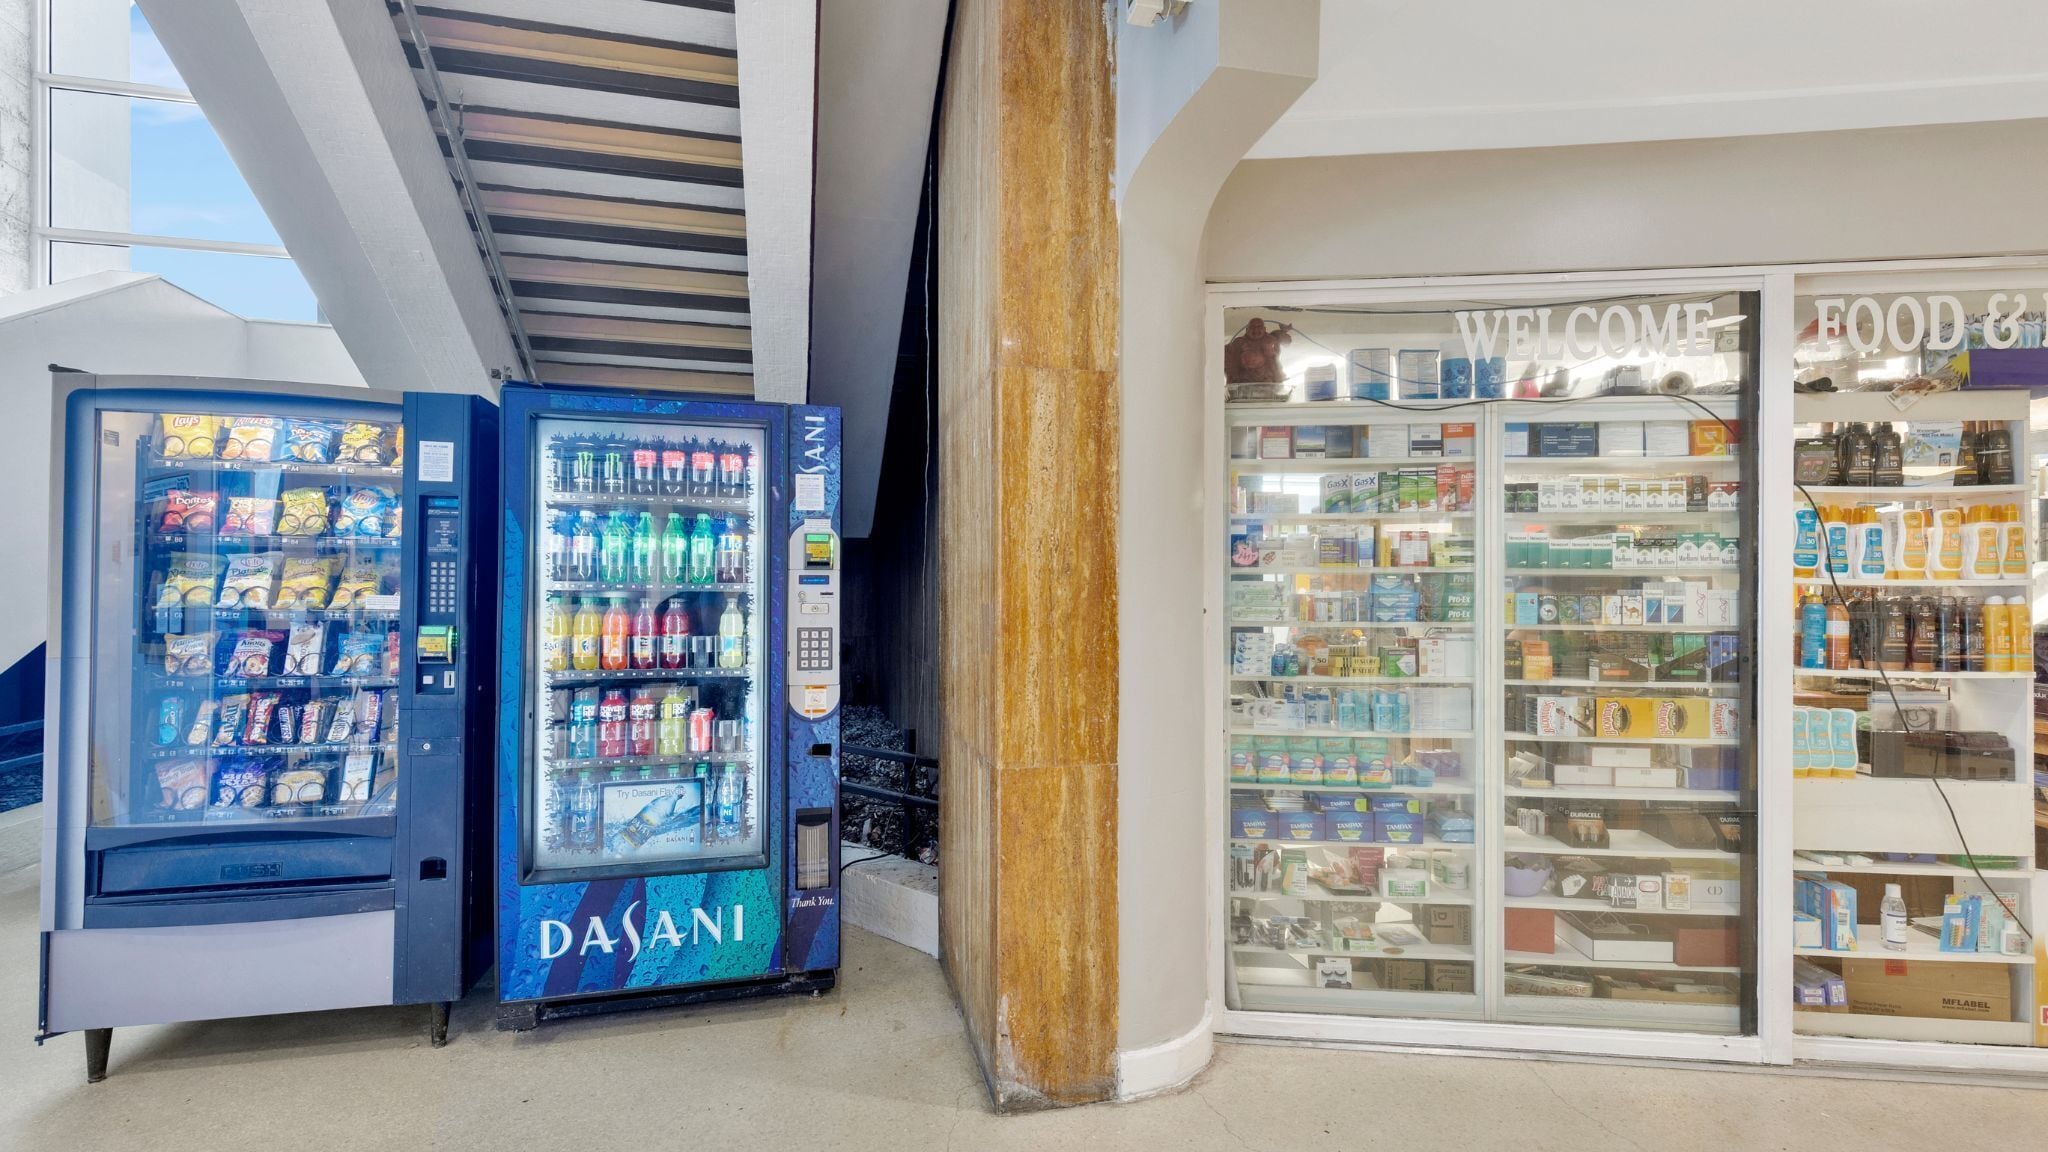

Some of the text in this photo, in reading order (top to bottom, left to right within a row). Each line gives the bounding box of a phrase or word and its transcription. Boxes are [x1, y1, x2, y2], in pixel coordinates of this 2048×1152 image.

[1454, 302, 1715, 364] WELCOME
[1814, 295, 1965, 352] FOOD
[1983, 292, 2028, 349] &
[798, 415, 831, 474] SANI
[617, 789, 630, 799] Try
[631, 787, 658, 797] Dasani
[540, 900, 744, 963] DASANI
[791, 896, 816, 908] Thank
[1942, 997, 1991, 1009] MFLABEL
